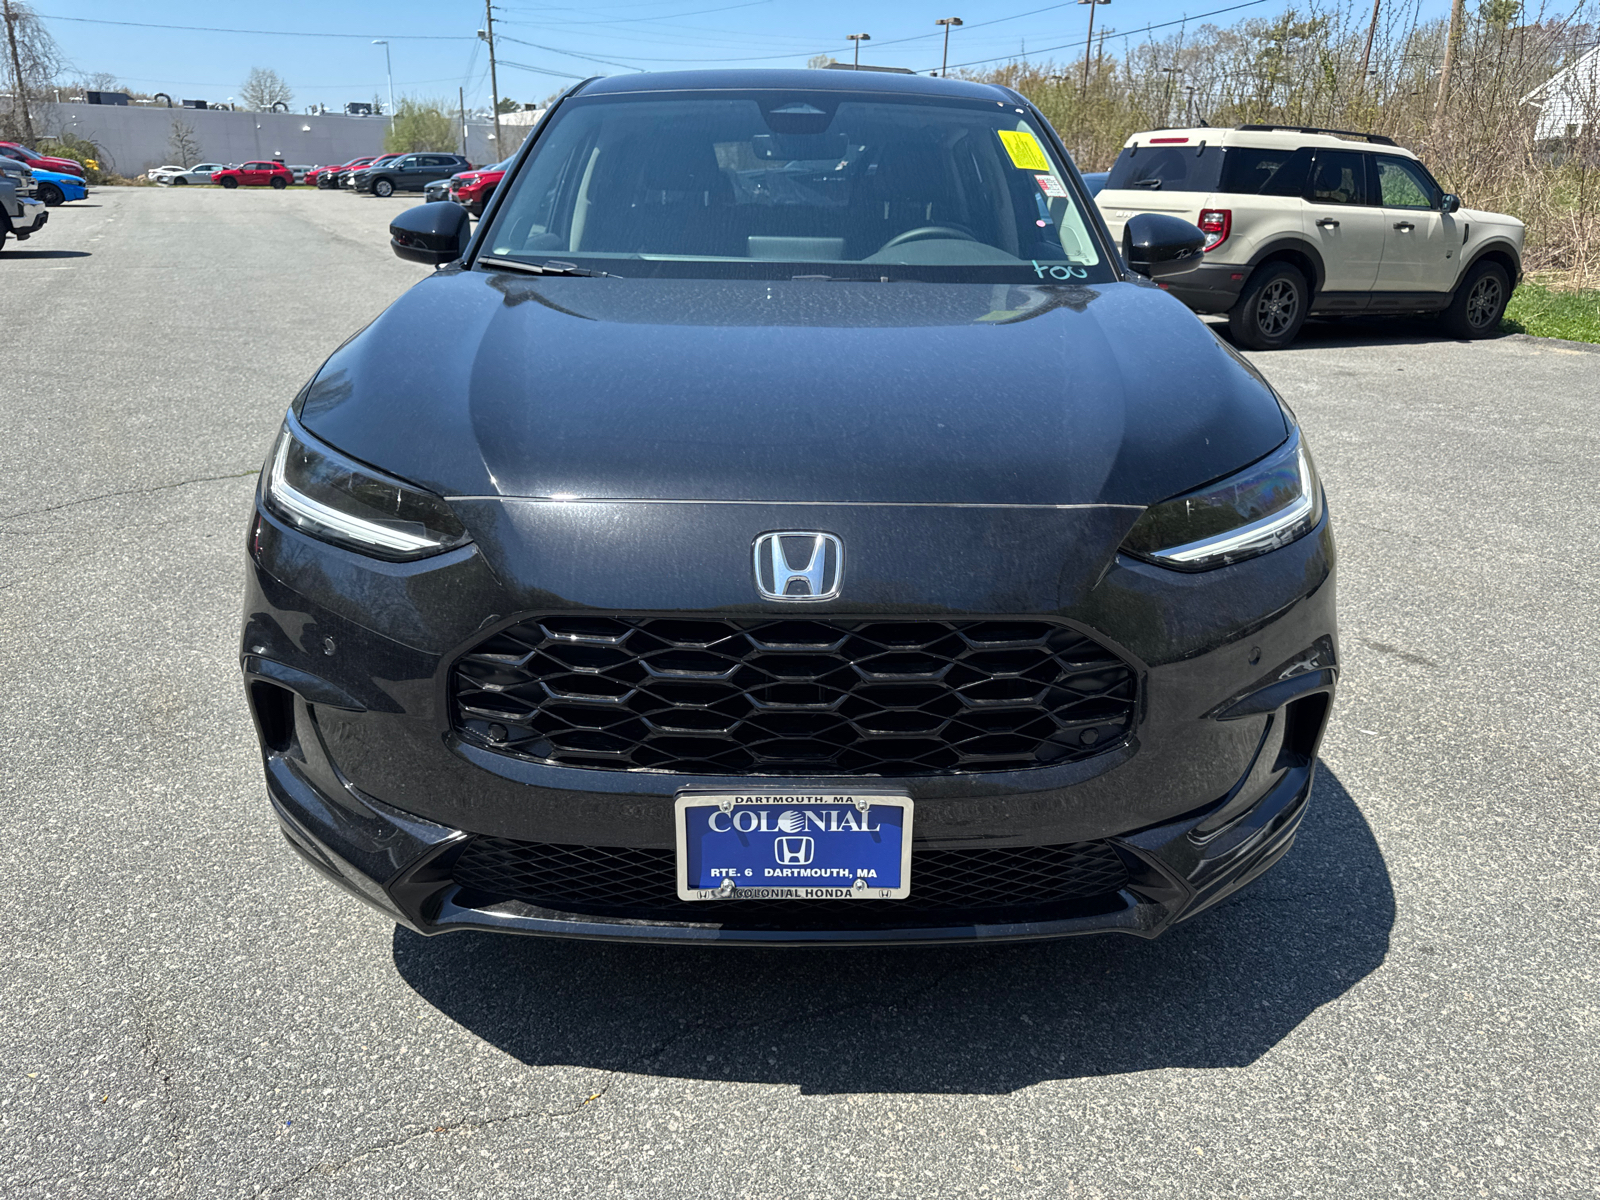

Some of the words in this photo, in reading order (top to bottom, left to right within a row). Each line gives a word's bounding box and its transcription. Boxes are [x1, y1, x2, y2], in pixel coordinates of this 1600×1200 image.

[735, 796, 828, 804] DARTMOUTH,
[708, 810, 881, 834] COLONIAL
[711, 868, 741, 877] RTE.
[744, 868, 753, 877] 6
[764, 868, 853, 879] DARTMOUTH,
[857, 868, 878, 878] MA
[735, 888, 801, 898] COLONIAL
[805, 888, 853, 898] HONDA
